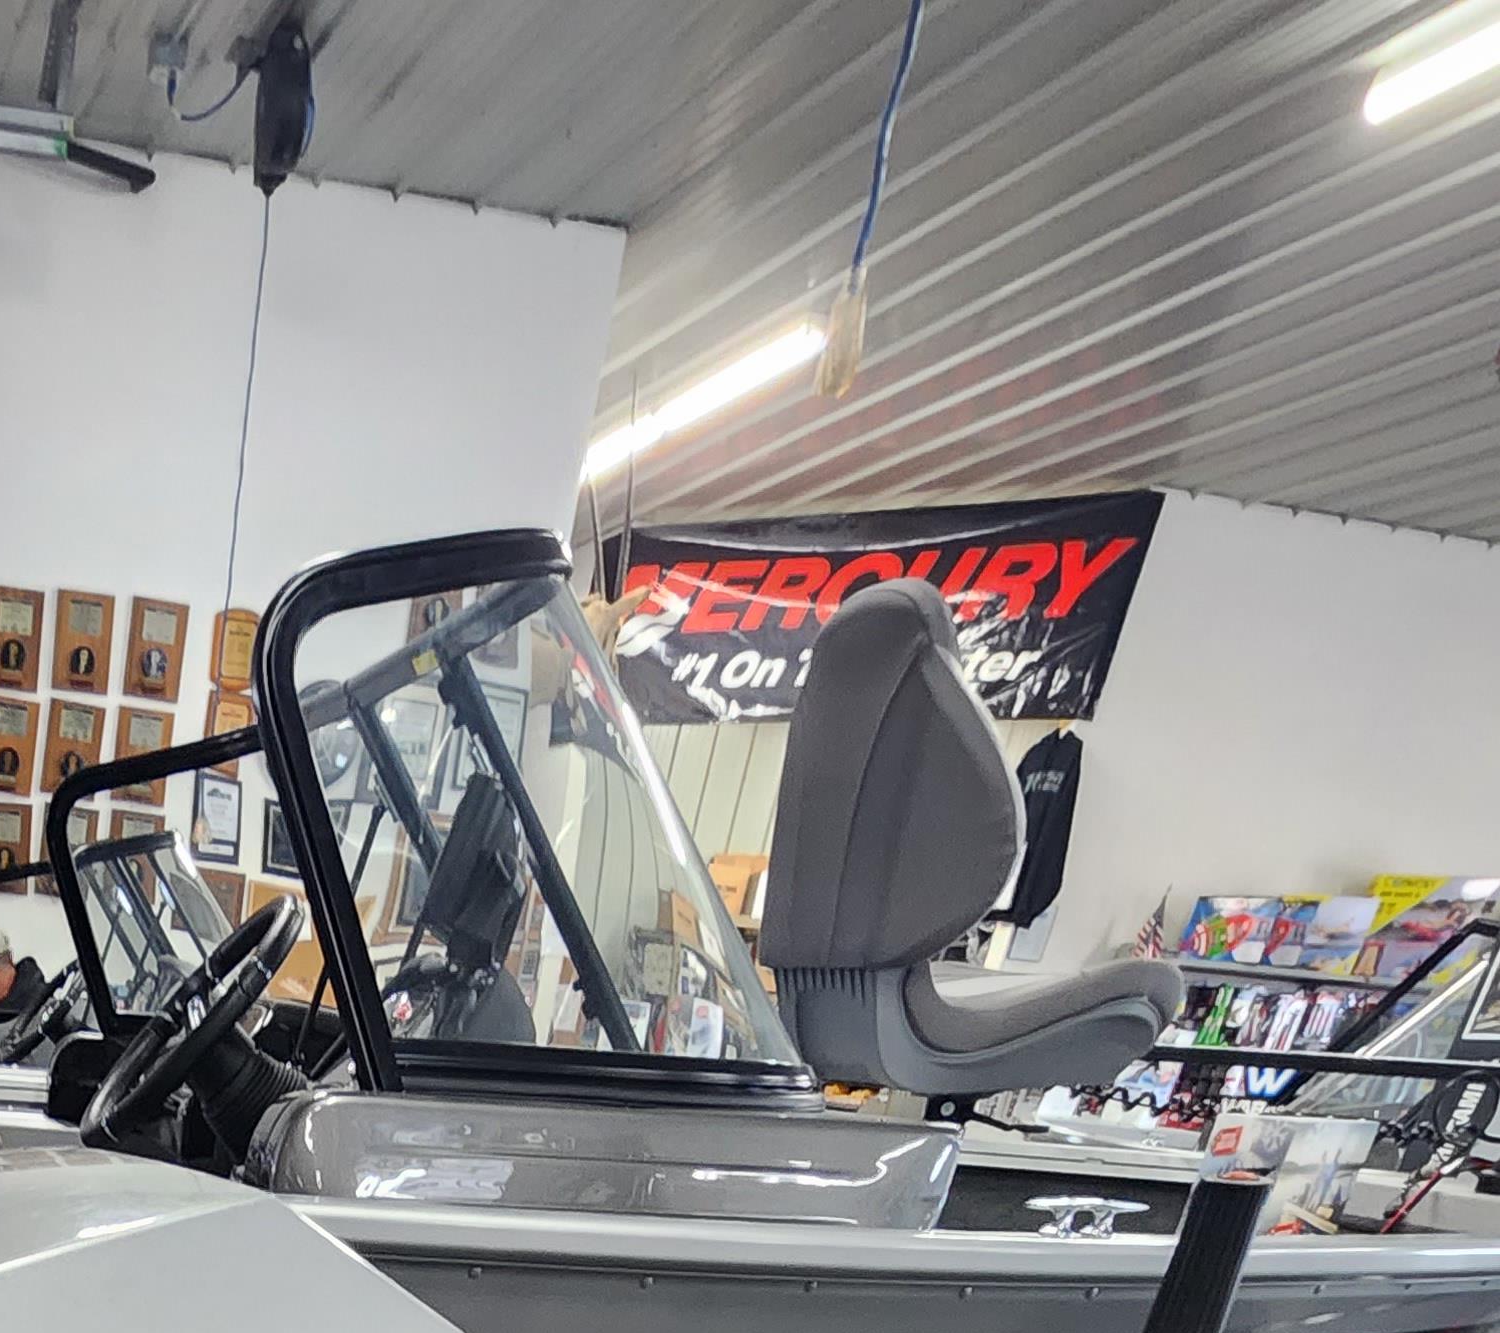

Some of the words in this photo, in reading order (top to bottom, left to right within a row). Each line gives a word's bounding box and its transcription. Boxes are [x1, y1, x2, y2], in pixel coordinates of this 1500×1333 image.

[671, 652, 718, 688] #1
[720, 651, 787, 689] On
[958, 645, 1042, 682] ter
